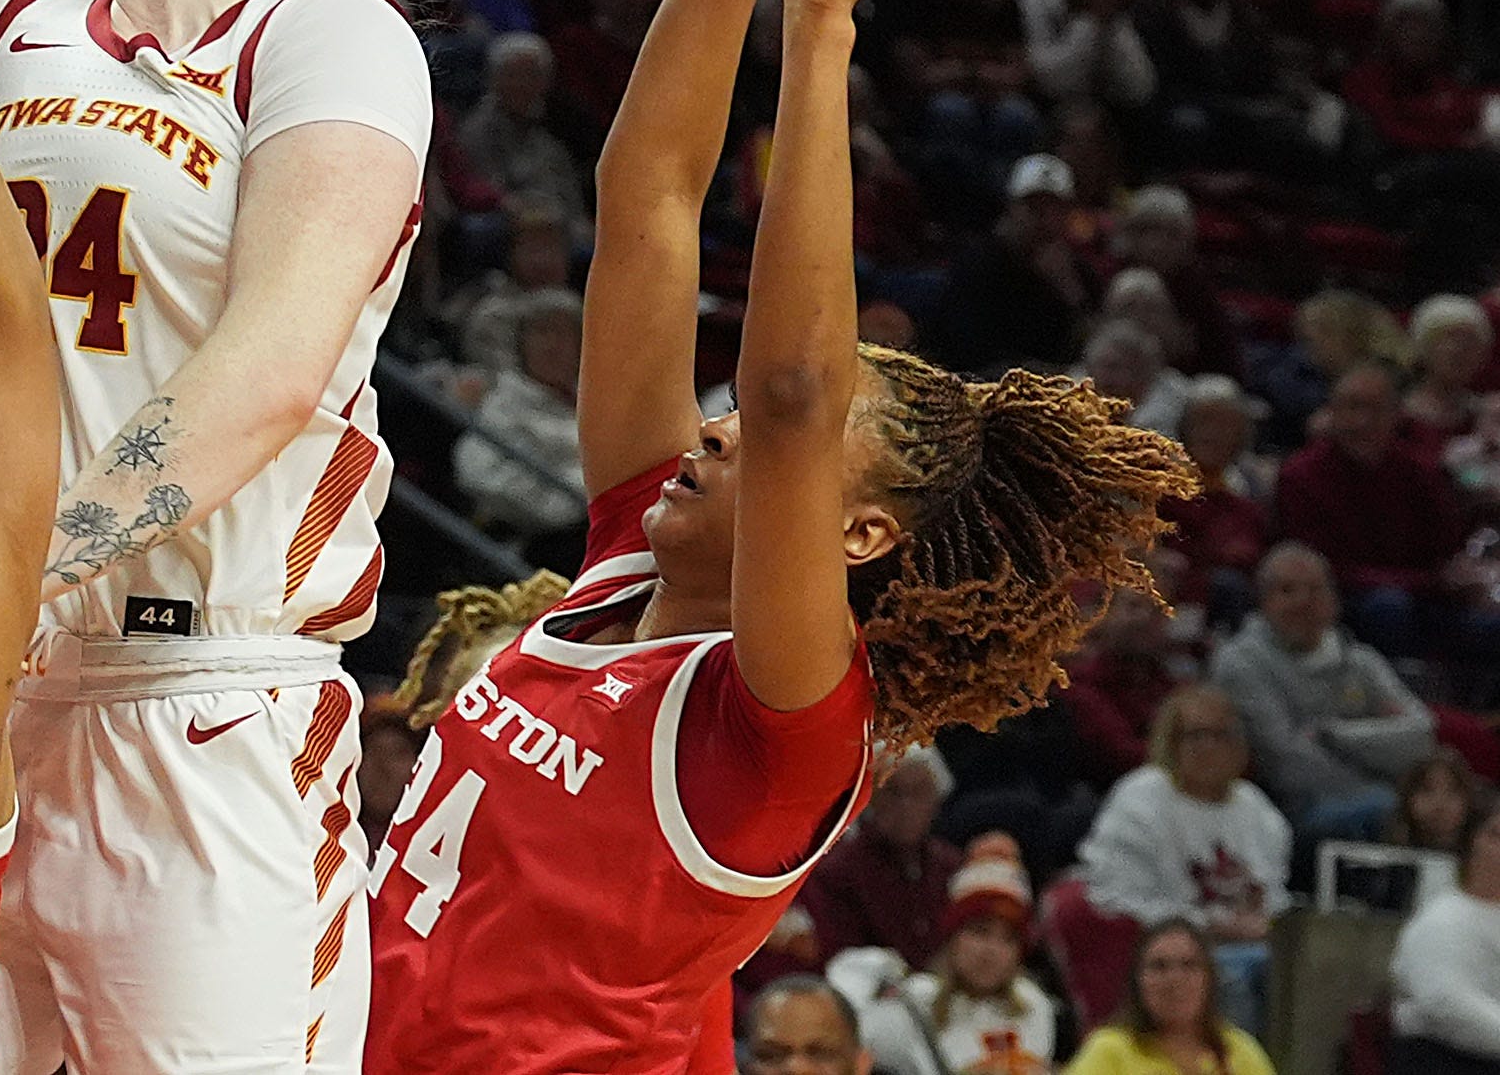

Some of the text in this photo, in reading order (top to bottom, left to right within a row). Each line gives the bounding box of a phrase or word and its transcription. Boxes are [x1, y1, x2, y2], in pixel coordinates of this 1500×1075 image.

[76, 100, 221, 190] STATE
[139, 606, 176, 627] 44
[455, 658, 604, 795] STON
